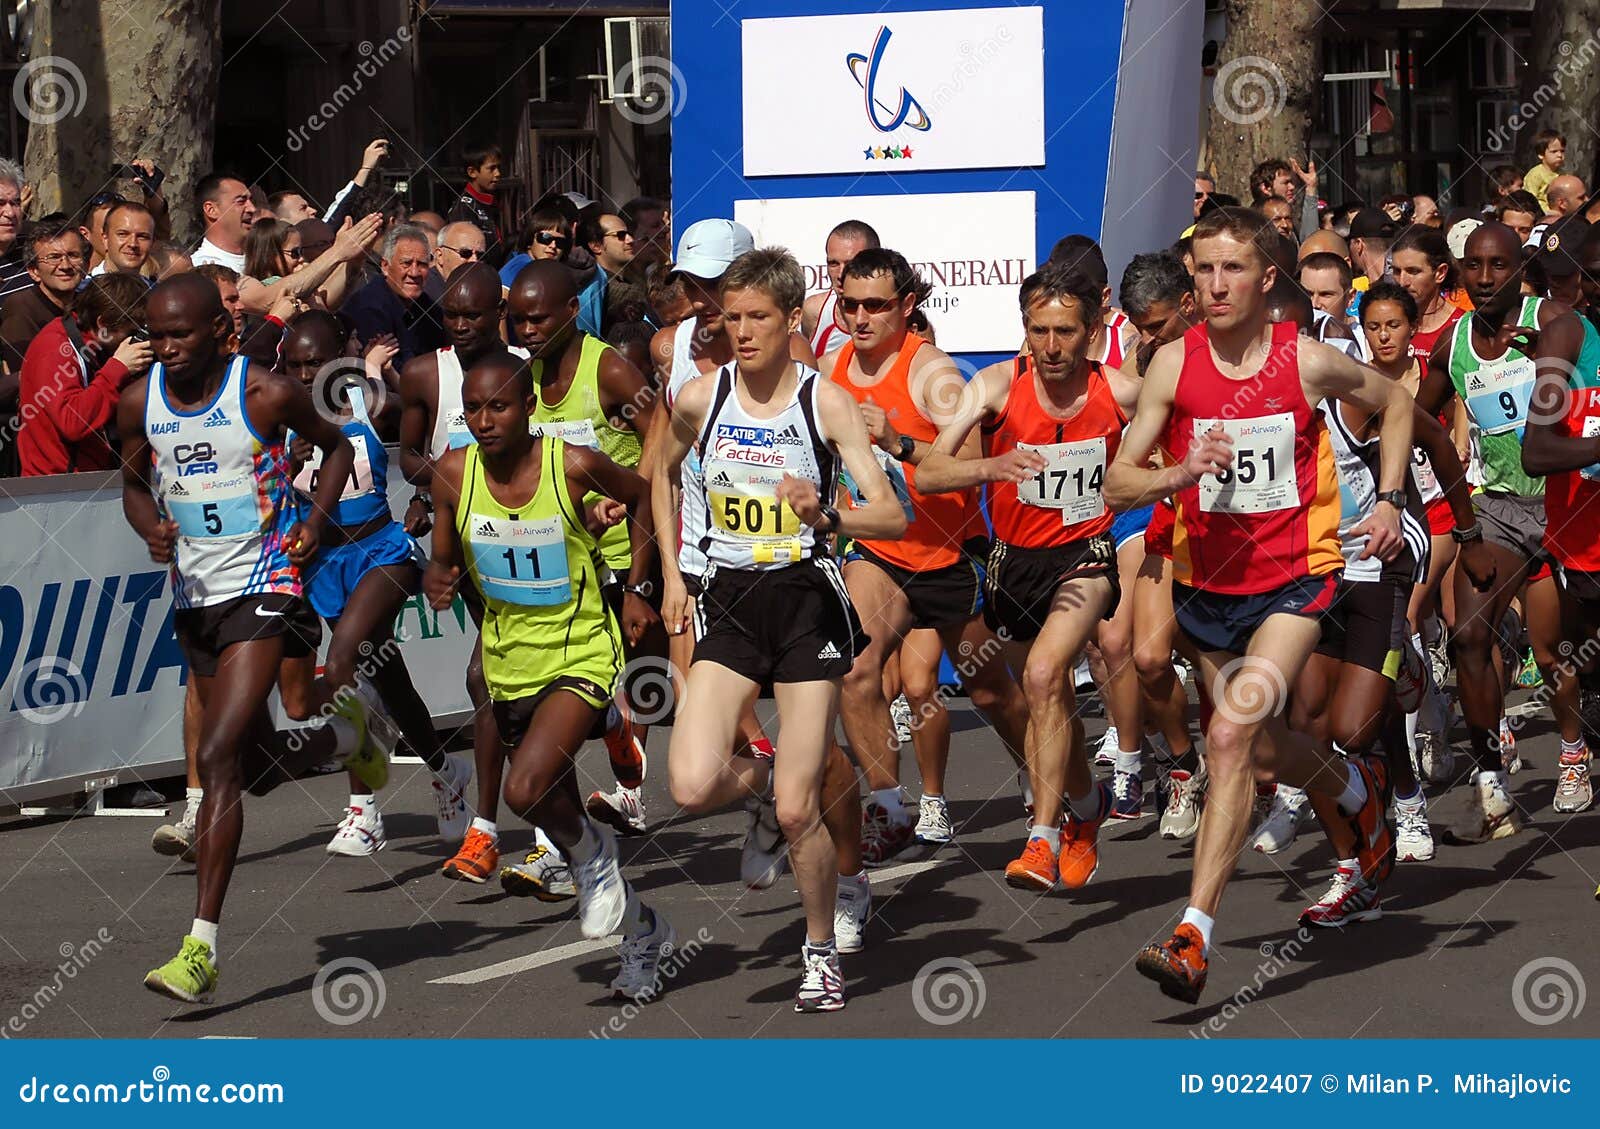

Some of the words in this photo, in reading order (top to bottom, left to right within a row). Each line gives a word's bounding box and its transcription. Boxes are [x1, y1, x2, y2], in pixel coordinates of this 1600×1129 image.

[1499, 391, 1518, 420] 9
[151, 422, 180, 435] MAPEI
[203, 420, 231, 428] adidas
[719, 427, 774, 442] ZLATIBOR
[774, 436, 804, 447] adidas
[726, 448, 785, 466] actavis
[712, 480, 734, 488] adidas
[1033, 464, 1103, 499] 1714
[203, 503, 223, 535] 5
[725, 497, 783, 534] 501
[476, 530, 500, 538] adidas
[502, 547, 541, 579] 11
